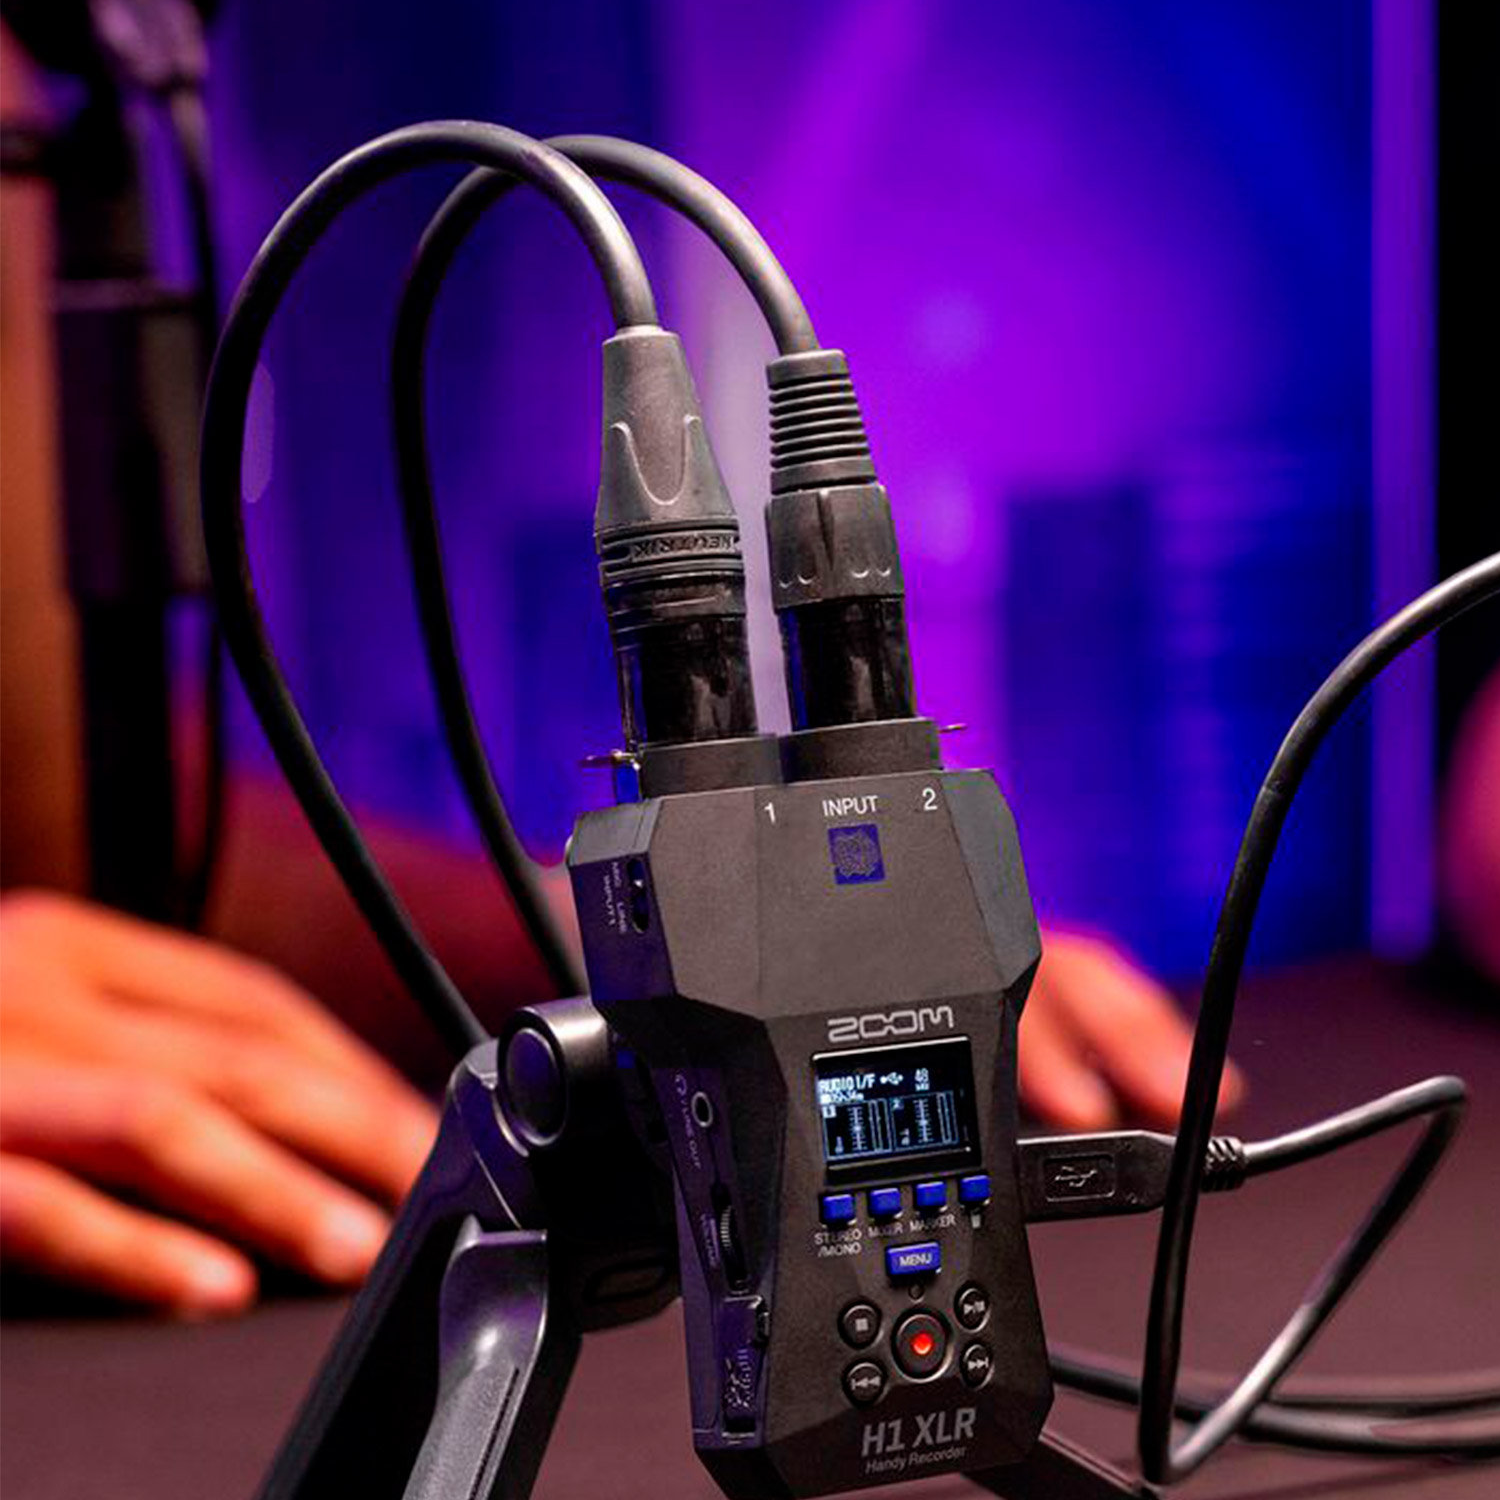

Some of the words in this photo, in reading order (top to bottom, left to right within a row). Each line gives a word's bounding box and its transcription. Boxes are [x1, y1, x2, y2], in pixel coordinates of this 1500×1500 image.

[764, 801, 776, 824] 1
[822, 794, 879, 817] INPUT
[921, 787, 938, 811] 2
[827, 1005, 954, 1043] ZOOM
[899, 1252, 933, 1267] MENU
[861, 1418, 906, 1457] H1
[912, 1407, 977, 1448] XLR
[865, 1457, 907, 1474] Handy
[908, 1445, 968, 1467] Recorder
